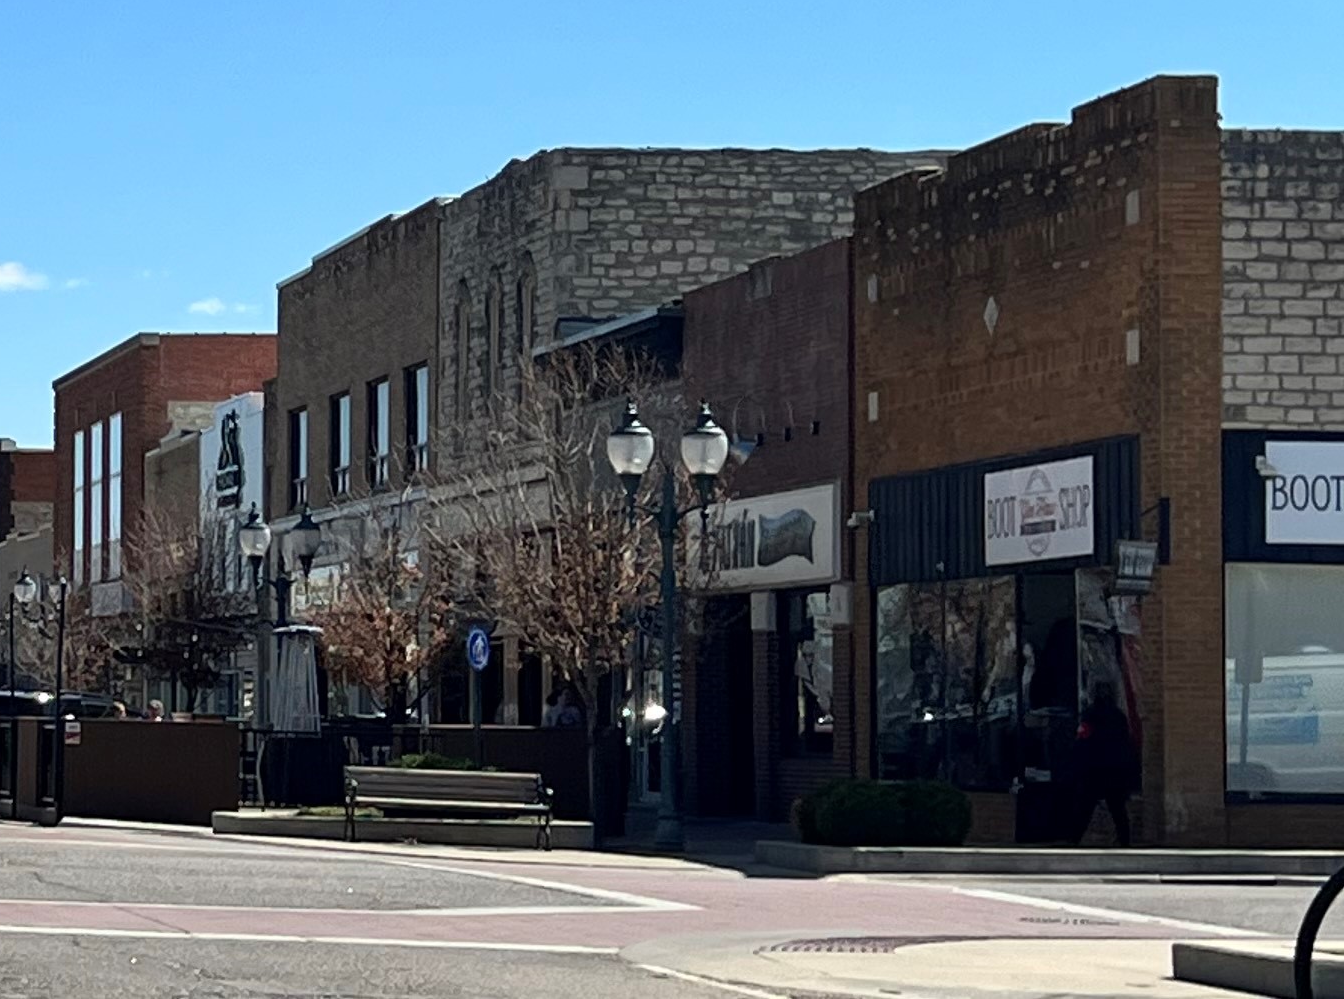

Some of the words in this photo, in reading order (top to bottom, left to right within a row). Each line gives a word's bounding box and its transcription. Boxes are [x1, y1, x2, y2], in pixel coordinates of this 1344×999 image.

[987, 496, 1017, 539] BOOT
[1058, 484, 1090, 531] SHOP
[1272, 474, 1344, 512] BOOT
